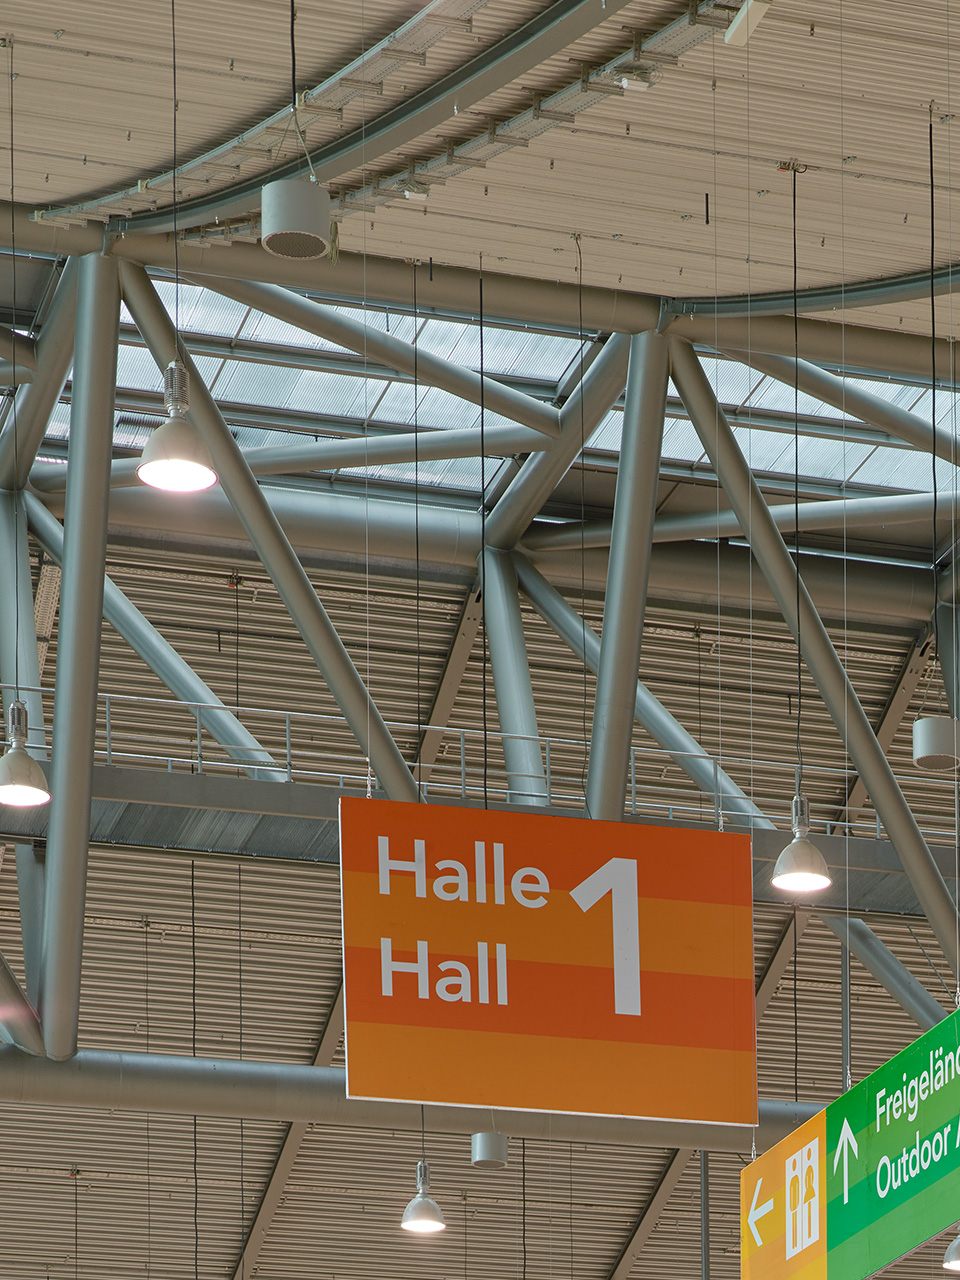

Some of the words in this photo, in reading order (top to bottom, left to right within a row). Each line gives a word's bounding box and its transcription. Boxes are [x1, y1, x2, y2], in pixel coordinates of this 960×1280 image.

[377, 835, 550, 909] Halle
[569, 857, 641, 1016] 1
[380, 937, 508, 1006] Hall
[875, 1121, 950, 1199] Outdoor
